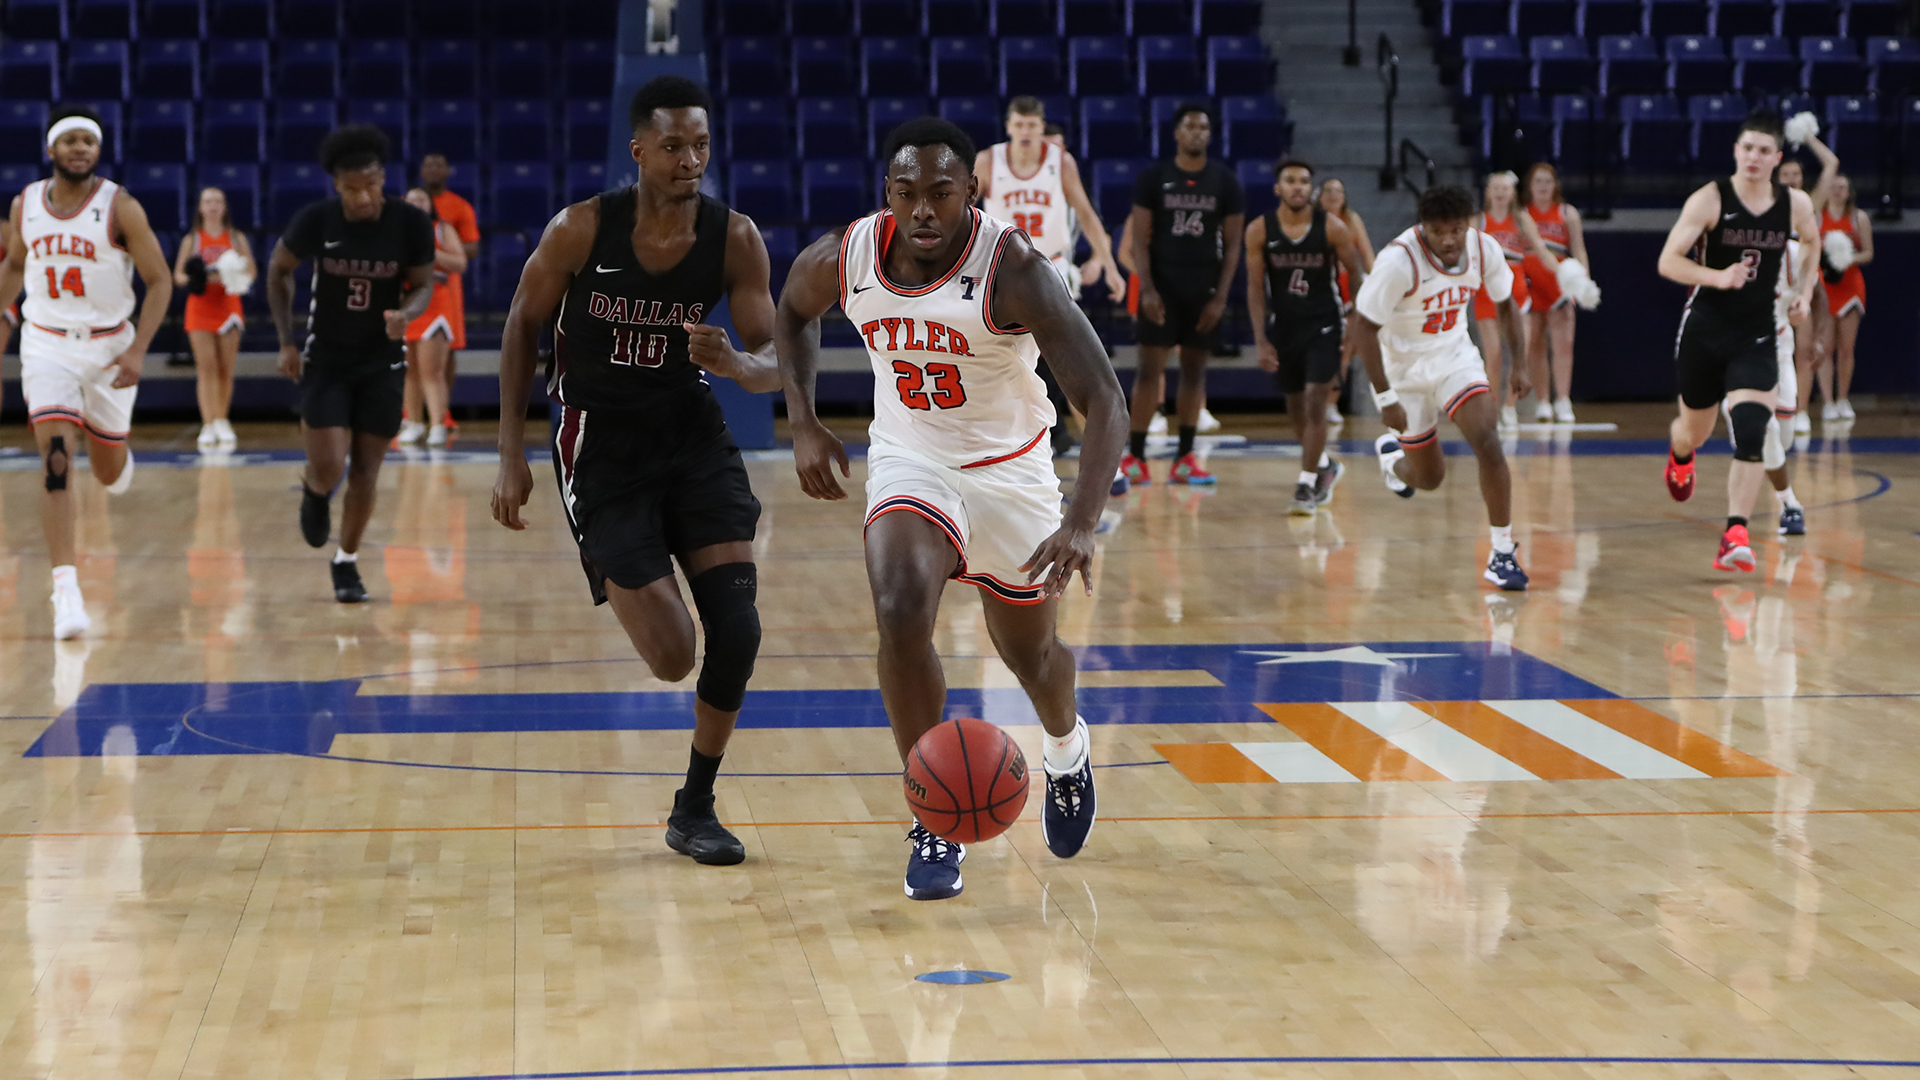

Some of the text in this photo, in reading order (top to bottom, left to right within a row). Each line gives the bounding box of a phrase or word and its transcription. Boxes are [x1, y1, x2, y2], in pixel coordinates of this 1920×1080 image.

[1003, 189, 1052, 208] TYLER
[31, 233, 97, 262] TYLER
[1721, 228, 1786, 249] DALLAS
[45, 265, 86, 299] 14
[346, 277, 372, 312] 3
[1287, 268, 1310, 296] 4
[588, 291, 703, 326] DALLAS
[610, 328, 668, 369] 10
[861, 317, 976, 357] TYLER
[891, 359, 968, 411] 23
